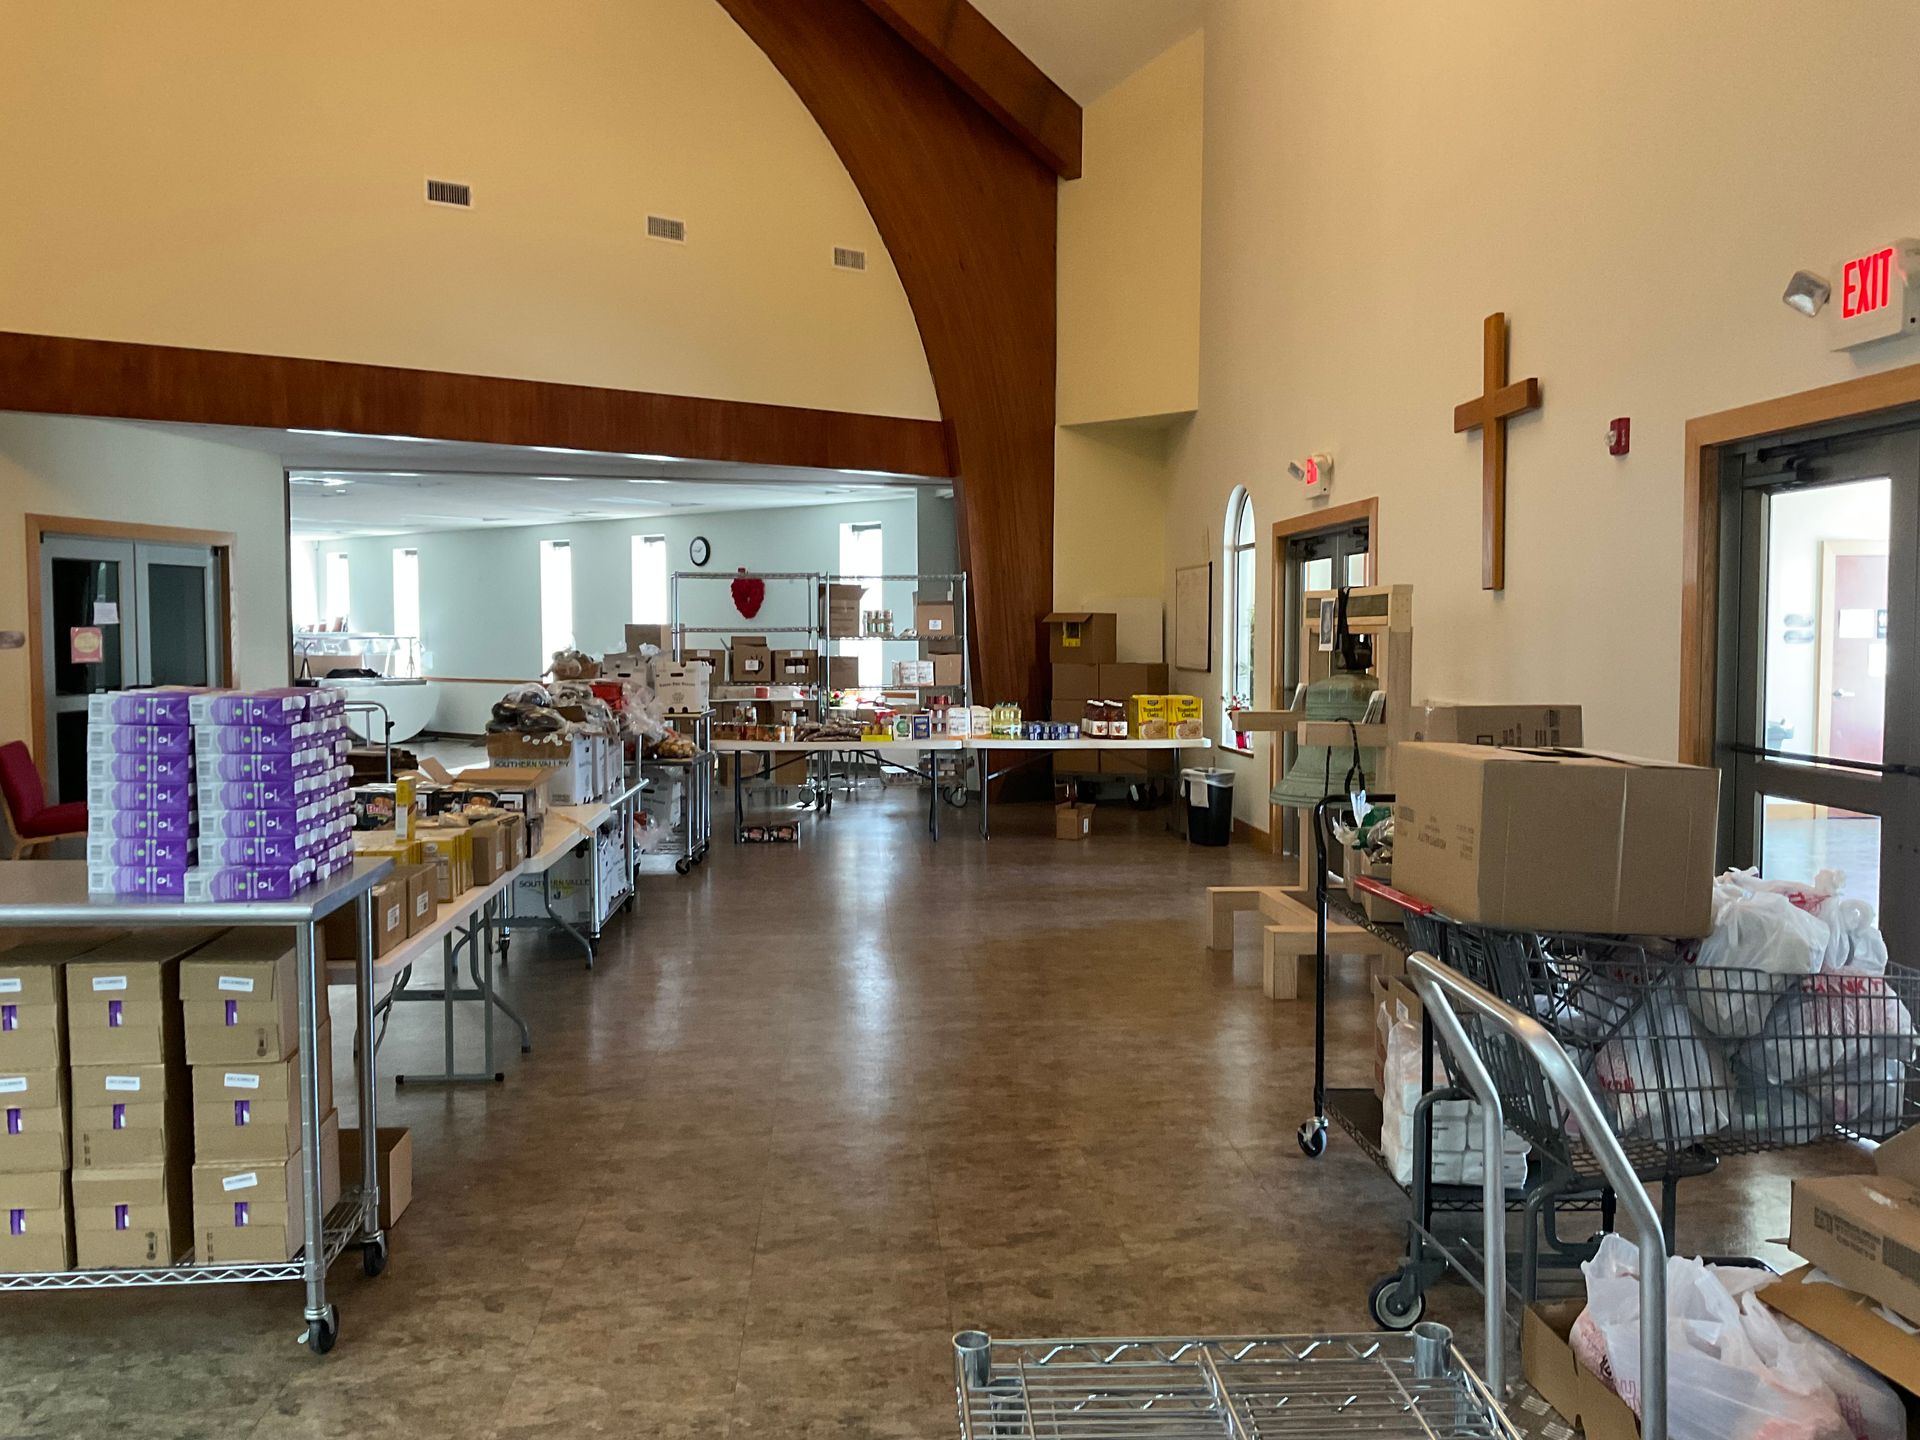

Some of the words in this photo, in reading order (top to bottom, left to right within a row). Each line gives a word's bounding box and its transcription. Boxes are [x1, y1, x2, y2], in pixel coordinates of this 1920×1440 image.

[1843, 248, 1893, 318] EXIT
[494, 760, 537, 768] SOUTHERN
[519, 879, 563, 888] SOUTRN
